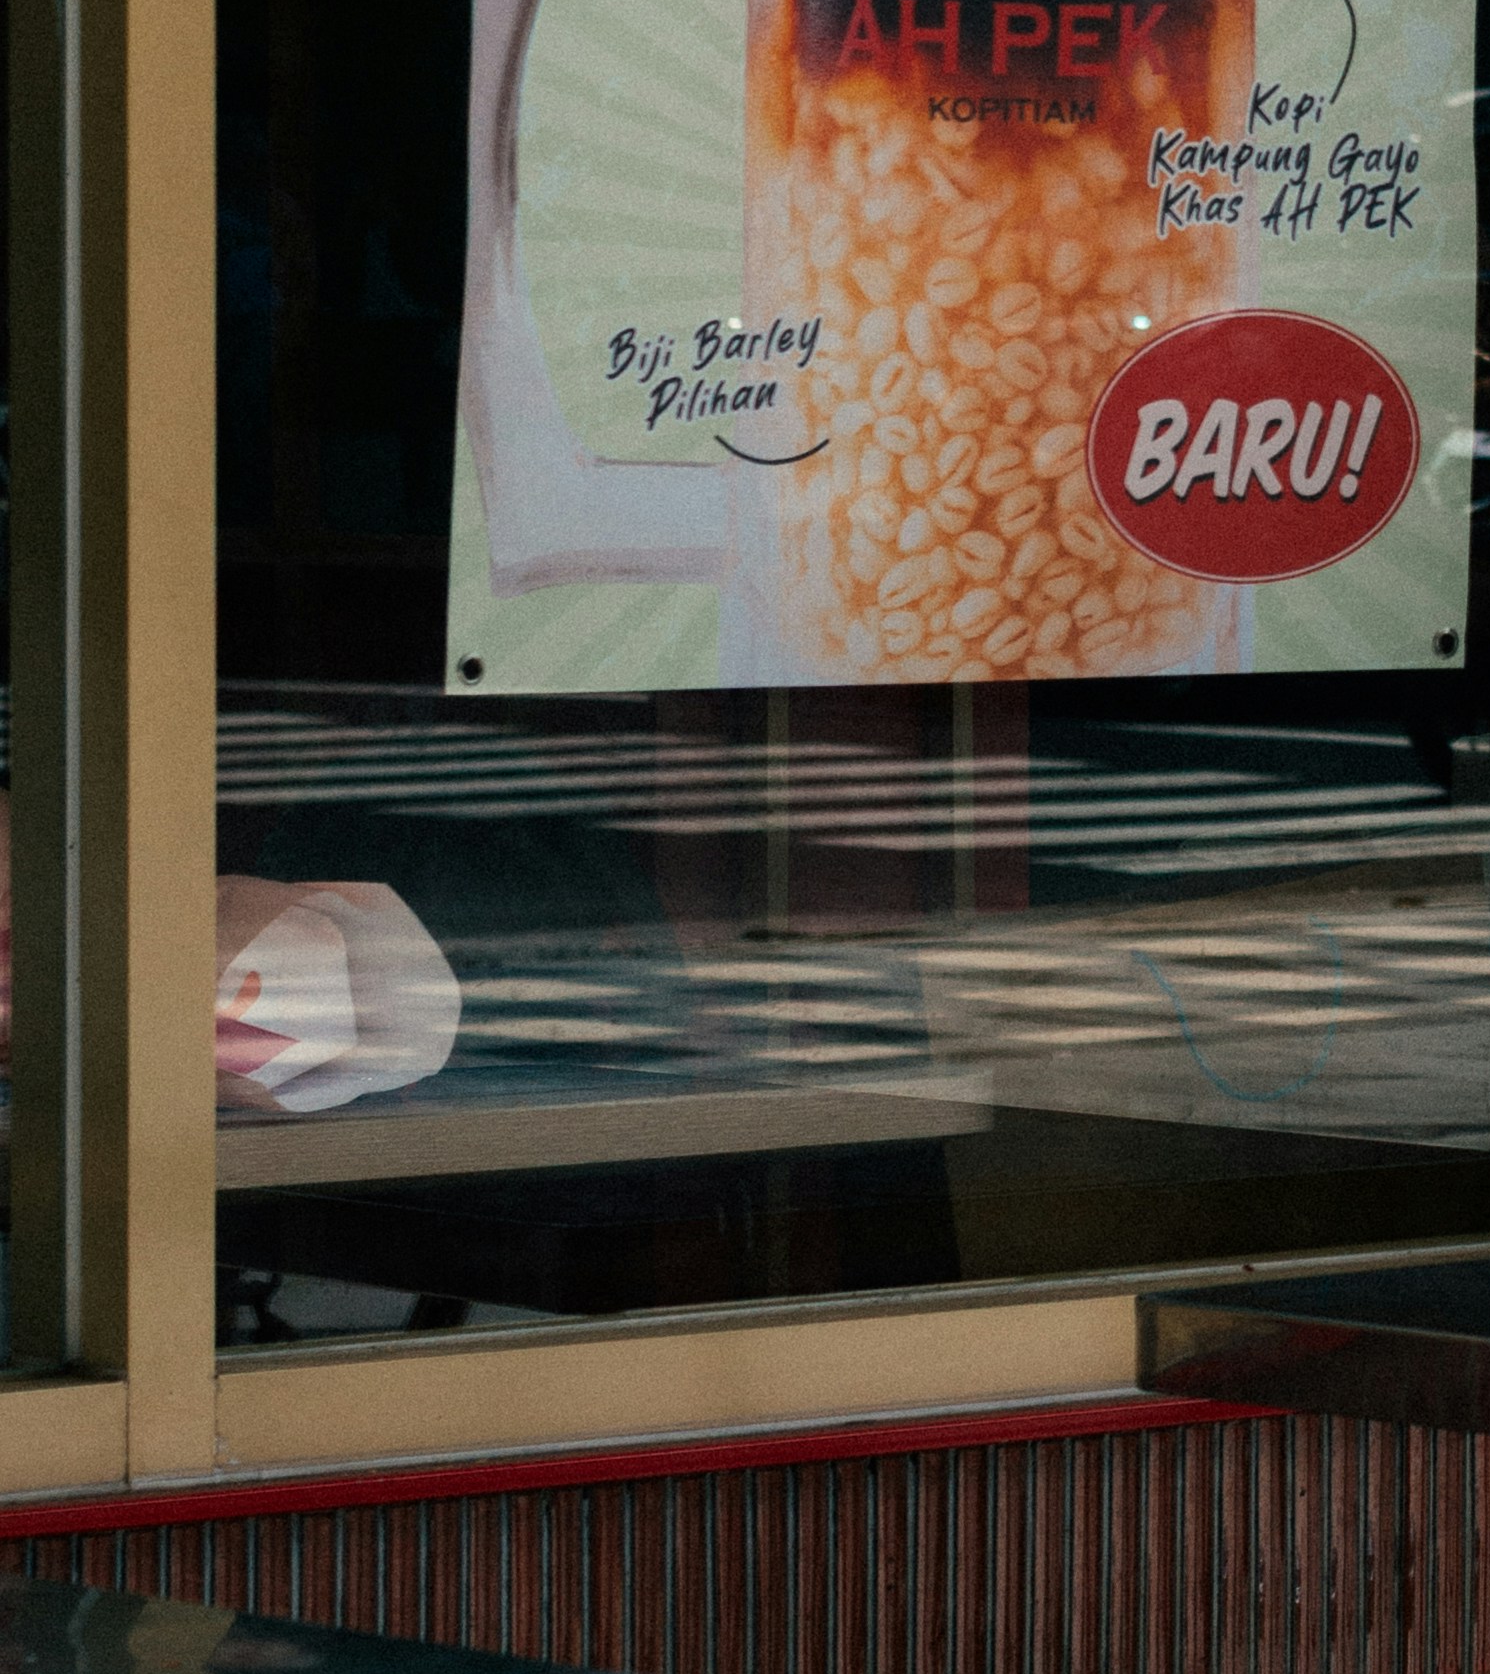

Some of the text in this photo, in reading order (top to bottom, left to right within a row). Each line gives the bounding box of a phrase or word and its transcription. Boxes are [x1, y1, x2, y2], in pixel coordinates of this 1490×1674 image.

[991, 2, 1169, 78] PEK
[927, 96, 1098, 124] KOPITIAM
[1248, 82, 1325, 135] Kopi
[1150, 131, 1420, 186] Kampung Gayo
[1158, 182, 1421, 241] Khas AH PEK
[606, 317, 822, 383] Biji Barley
[645, 376, 778, 431] Pilihan
[1123, 393, 1383, 505] BARU!
